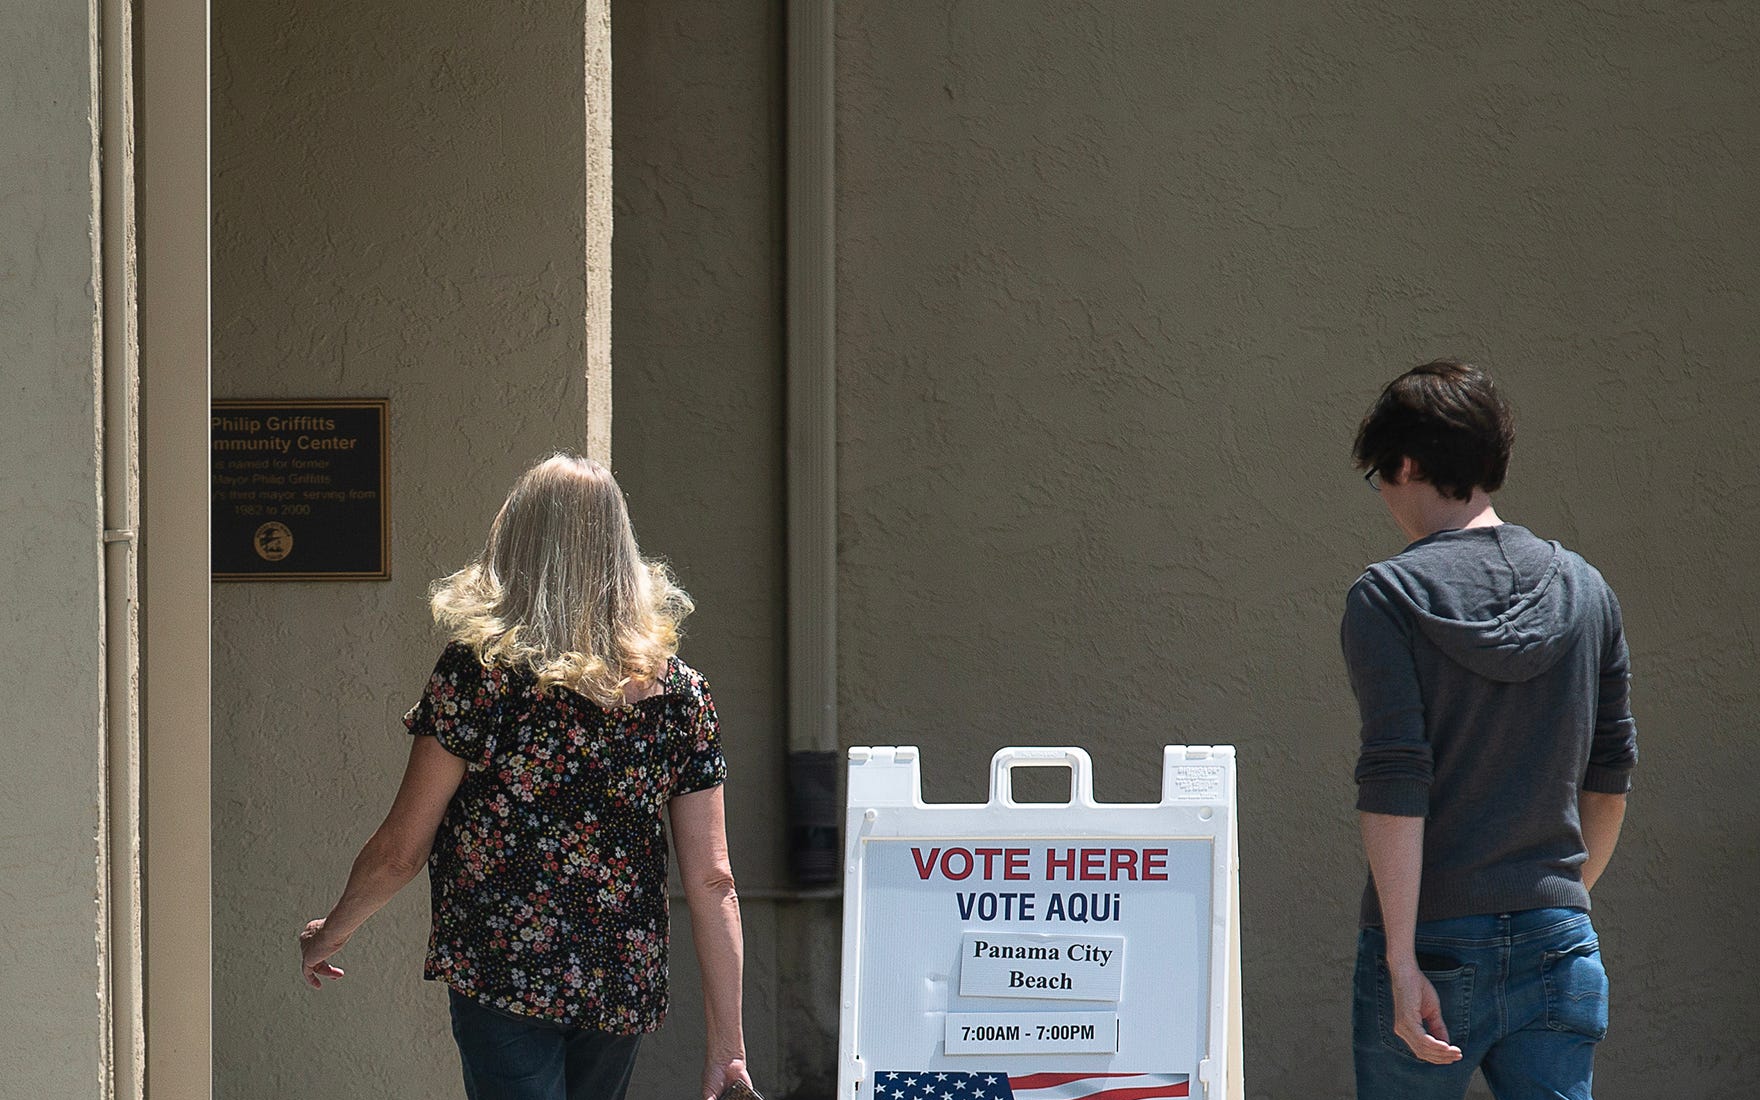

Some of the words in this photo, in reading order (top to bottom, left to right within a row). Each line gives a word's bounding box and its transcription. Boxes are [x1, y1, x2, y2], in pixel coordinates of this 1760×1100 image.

[211, 416, 261, 433] Philip
[266, 416, 336, 431] Griffitts
[212, 436, 291, 453] mmunity
[297, 435, 357, 450] Center
[273, 458, 288, 469] for
[303, 490, 345, 502] serving
[349, 489, 376, 500] from
[910, 848, 1030, 881] VOTE
[1046, 848, 1169, 881] HERE
[956, 893, 1035, 921] VOTE
[973, 940, 1060, 961] Panama
[1067, 943, 1113, 967] City
[1009, 971, 1073, 990] Beach
[961, 1026, 1020, 1041] 7:00AM
[1036, 1025, 1095, 1040] 7:00PM
